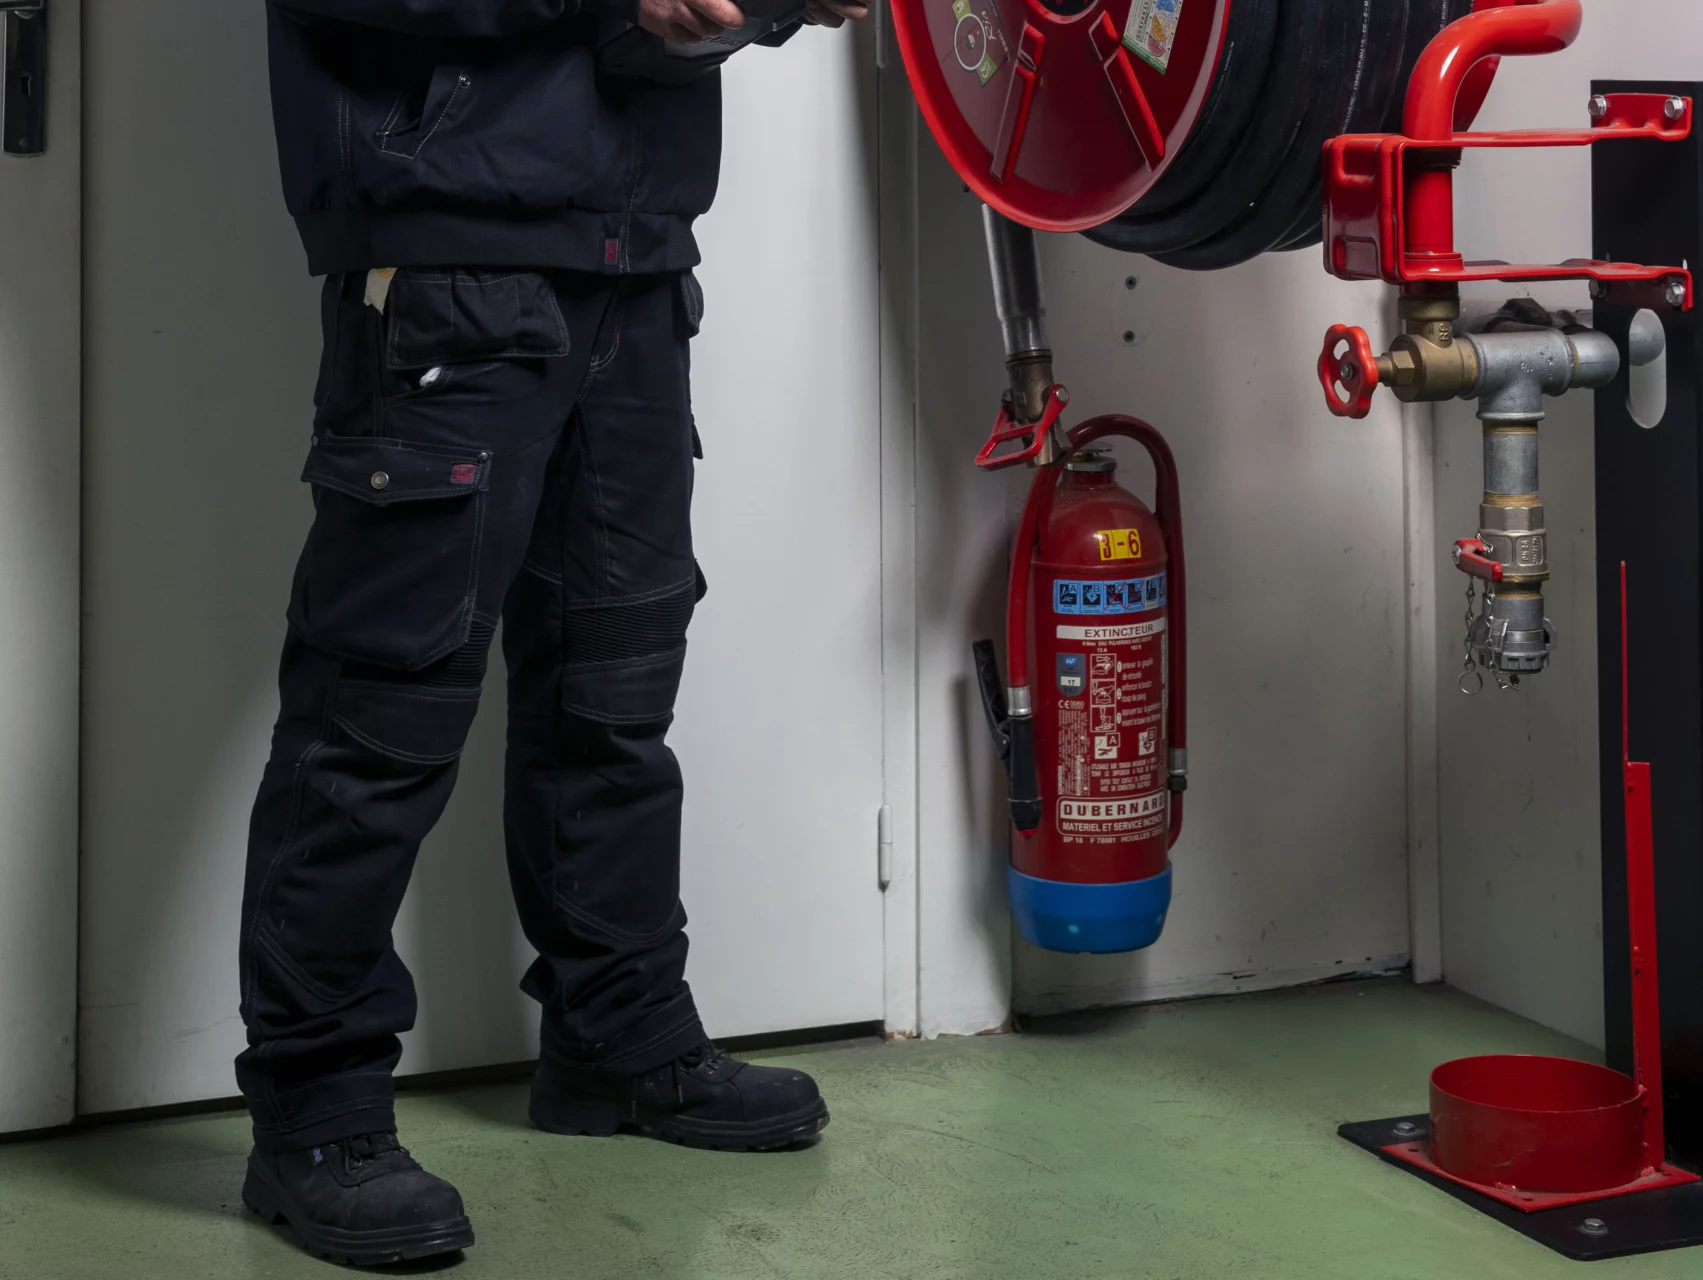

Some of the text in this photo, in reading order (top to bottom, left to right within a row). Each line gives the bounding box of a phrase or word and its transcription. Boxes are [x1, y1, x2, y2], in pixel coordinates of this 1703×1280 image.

[1070, 584, 1077, 592] A
[1094, 585, 1100, 593] B
[1084, 624, 1154, 638] EXTINCTEUR
[1109, 736, 1116, 744] A
[1062, 822, 1101, 832] MATERIEL
[1102, 823, 1112, 832] ET
[1113, 819, 1142, 831] SERVICE
